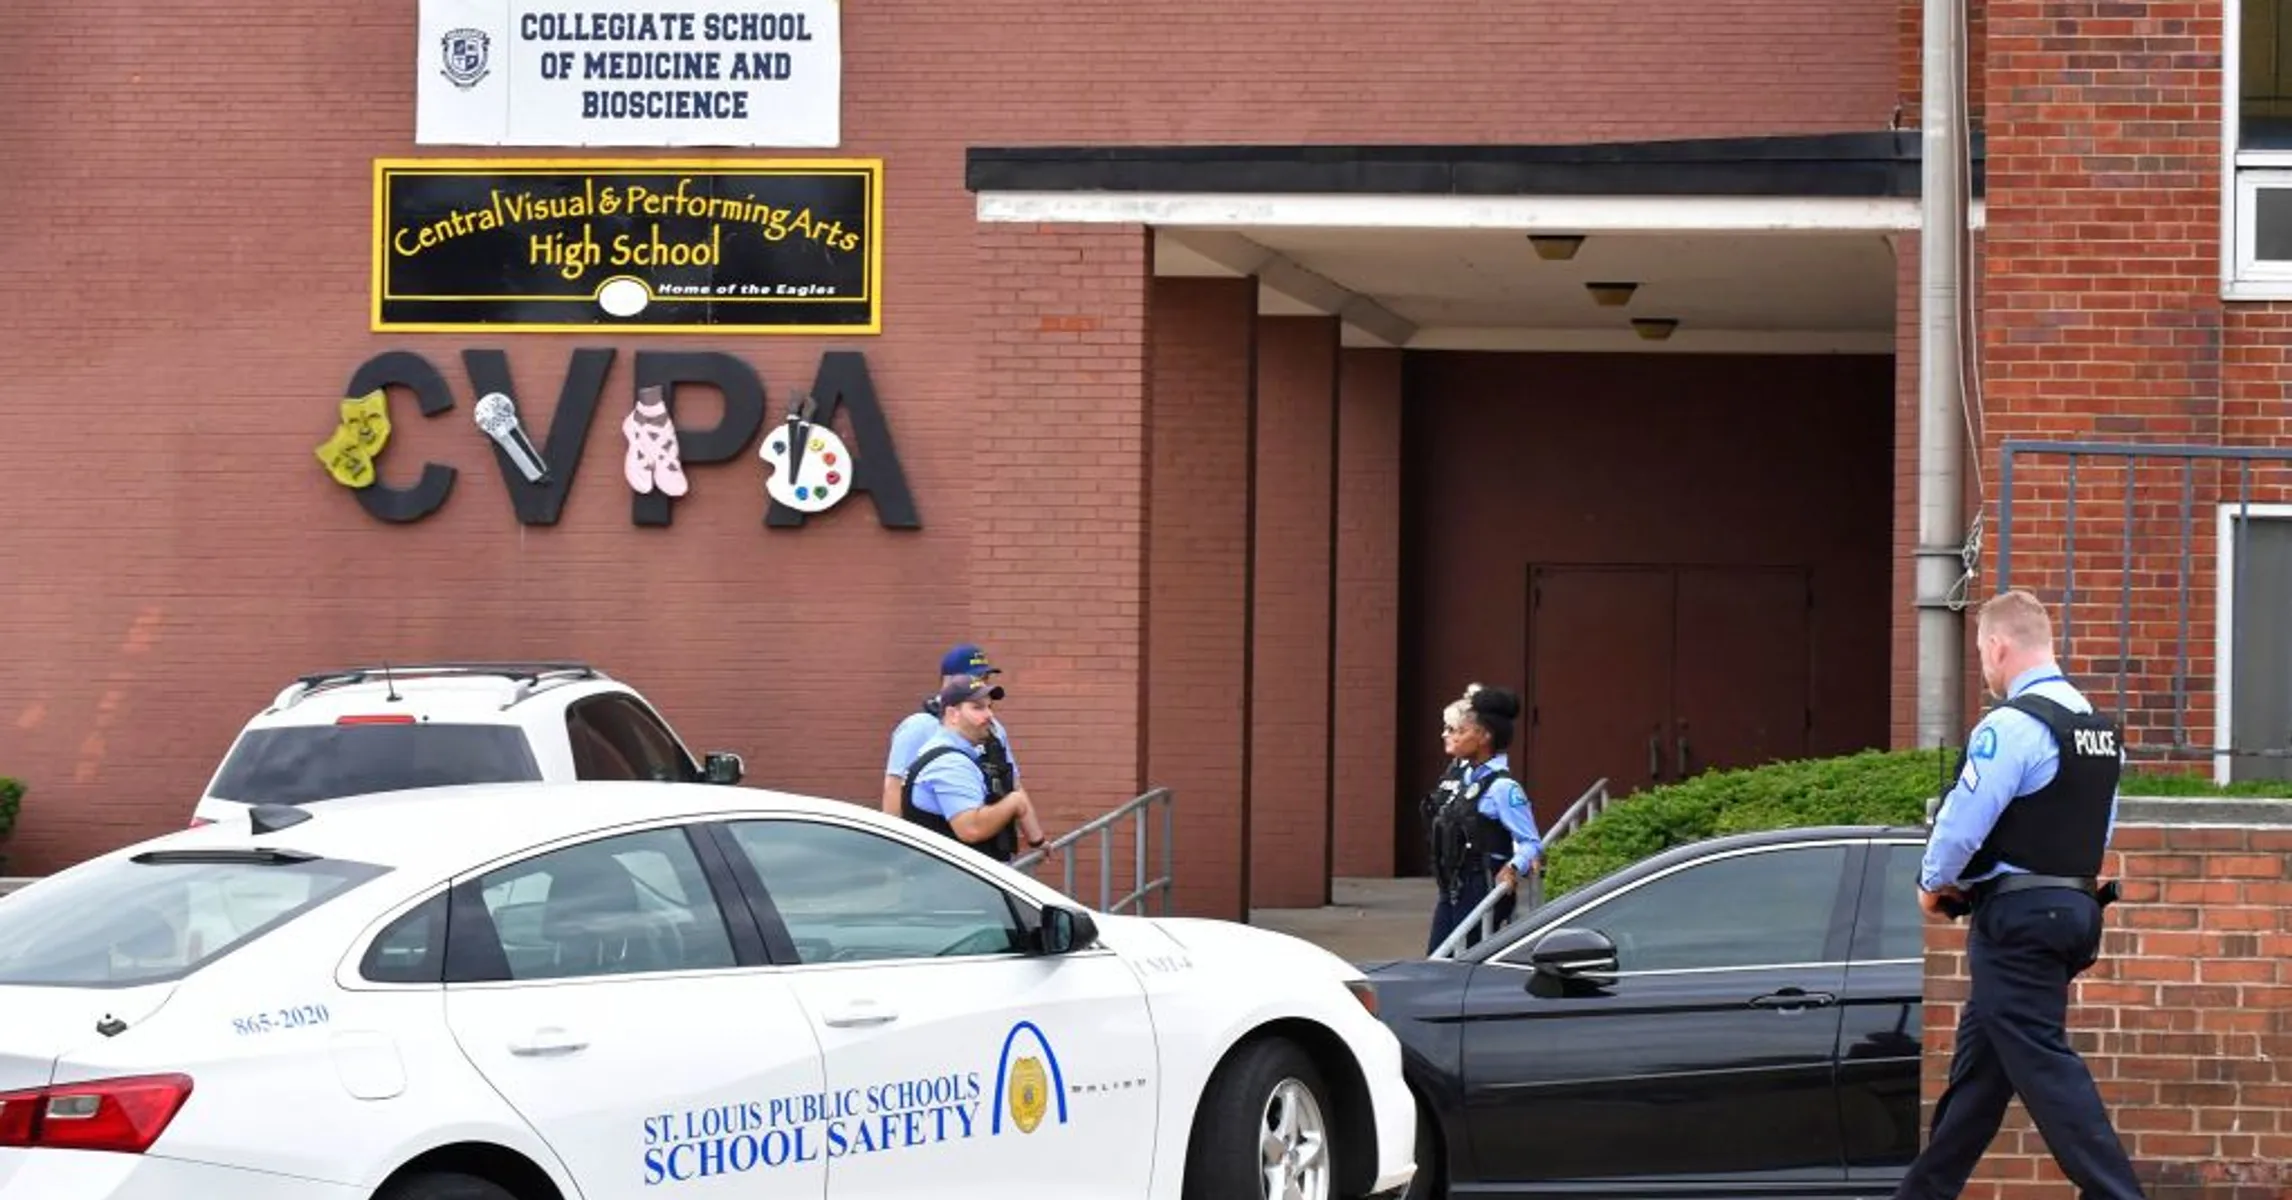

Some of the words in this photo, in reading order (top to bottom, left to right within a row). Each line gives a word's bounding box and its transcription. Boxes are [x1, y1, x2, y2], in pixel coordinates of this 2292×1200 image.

[520, 13, 695, 41] COLLEGIATE
[703, 13, 812, 41] SCHOOL
[541, 52, 575, 80] OF
[583, 52, 721, 80] MEDICINE
[729, 52, 792, 80] AND
[581, 91, 749, 119] BIOSCIENCE
[394, 189, 505, 256] Central
[504, 177, 594, 223] Visual
[600, 186, 622, 215] &
[627, 178, 791, 241] Performing
[788, 208, 860, 251] Arts
[530, 223, 601, 280] High
[610, 223, 720, 266] School
[658, 284, 711, 295] Home
[716, 284, 735, 295] of
[740, 284, 771, 295] the
[776, 284, 836, 297] Eagles
[346, 348, 923, 530] CVPA
[2074, 728, 2117, 757] POLICE
[232, 1003, 330, 1036] 865-2020
[644, 1114, 679, 1145] ST.
[686, 1101, 763, 1139] LOUIS
[769, 1087, 860, 1128] PUBLIC
[866, 1071, 981, 1114] SCHOOLS
[644, 1126, 819, 1186] SCHOOL
[827, 1101, 981, 1158] SAFETY
